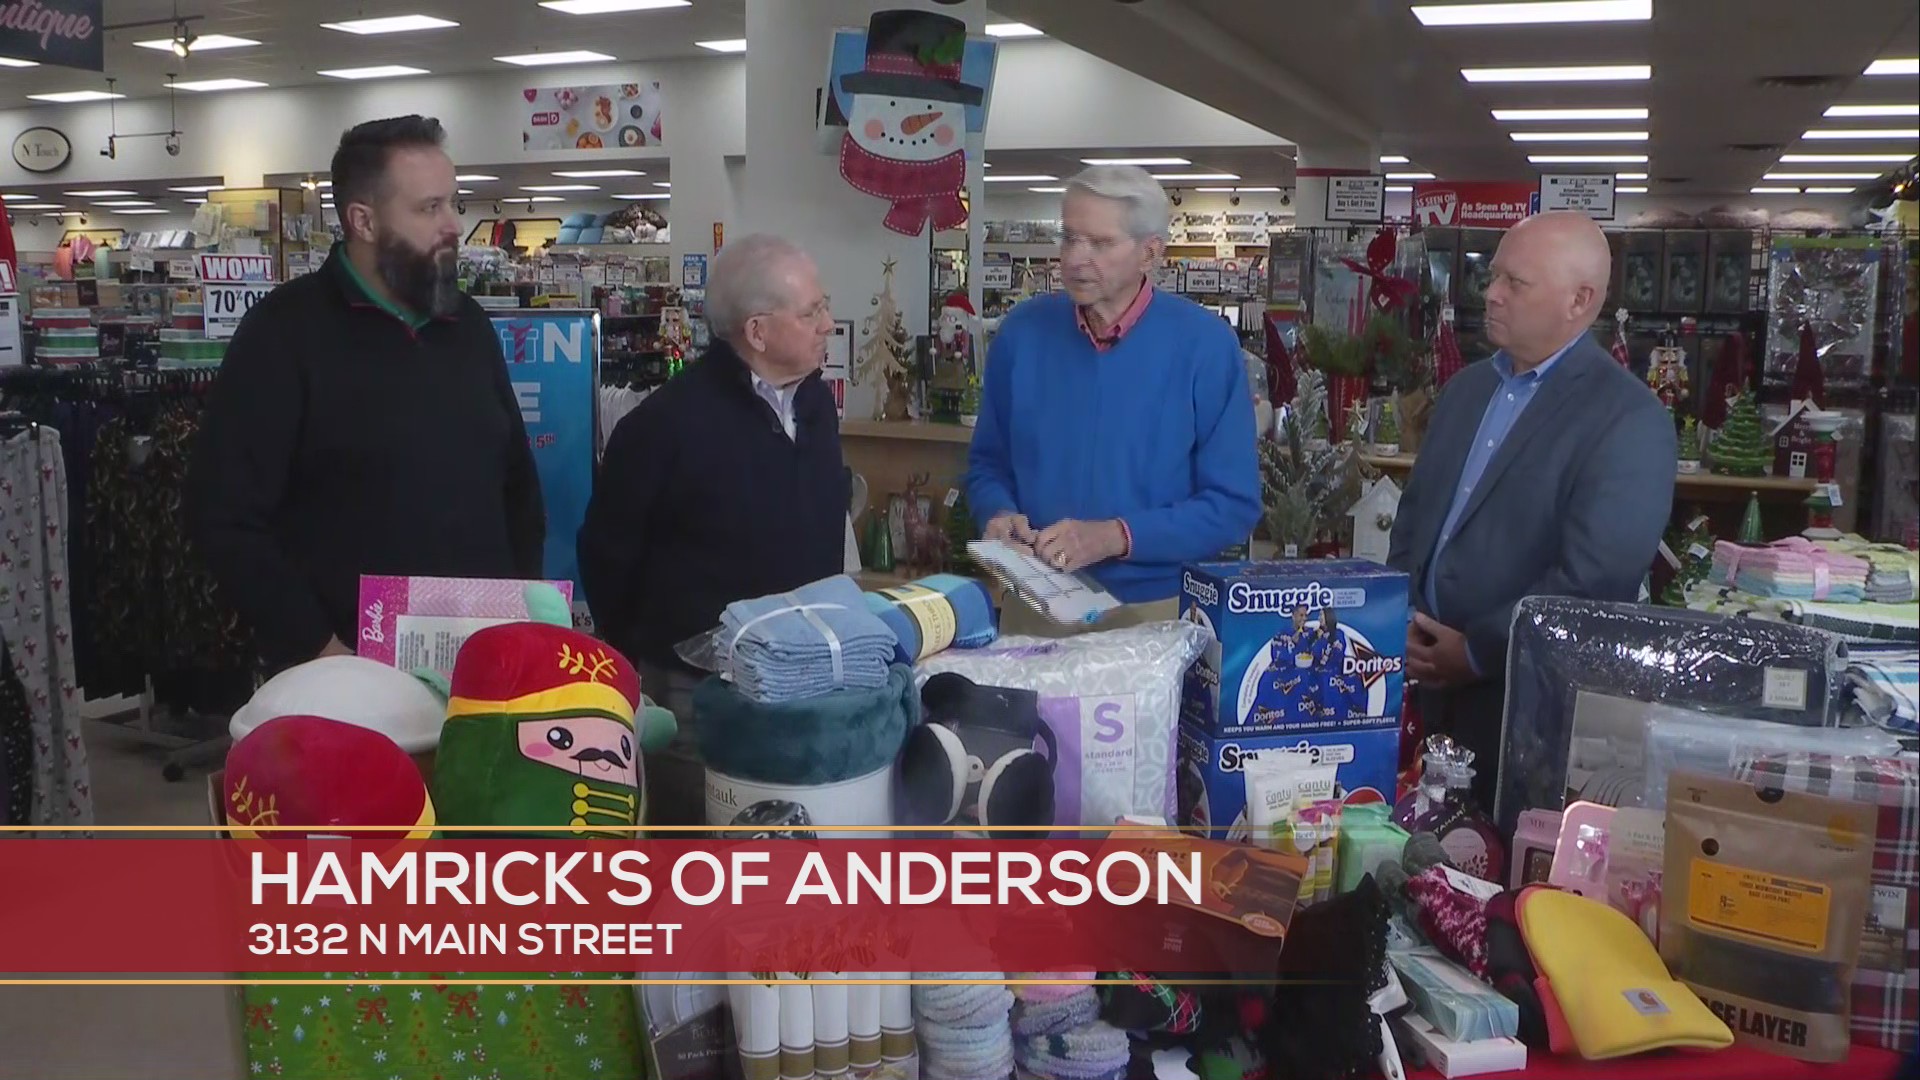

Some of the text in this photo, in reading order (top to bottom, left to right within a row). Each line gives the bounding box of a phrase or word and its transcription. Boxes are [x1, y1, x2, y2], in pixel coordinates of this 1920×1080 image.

[22, 143, 60, 157] N Touch
[1425, 195, 1443, 206] SEEN
[1444, 193, 1456, 202] ON
[1462, 202, 1528, 212] As Seen On TV
[1416, 202, 1457, 225] TV
[1461, 210, 1527, 221] Headquarters!
[203, 257, 273, 281] WOW!
[210, 289, 243, 314] 70%
[1183, 571, 1219, 605] Snuggie
[1228, 581, 1334, 618] Snuggie
[362, 598, 385, 644] Barbie
[1343, 654, 1403, 676] Doritos
[1093, 702, 1124, 743] S
[1224, 726, 1243, 734] KEEPS
[1255, 724, 1272, 732] WARM
[1285, 722, 1300, 730] YOUR
[1301, 721, 1319, 729] HANDS
[1085, 747, 1133, 760] standard
[1297, 779, 1331, 792] cantu
[1265, 788, 1292, 804] cantu
[1739, 1008, 1808, 1048] LAYER
[688, 1051, 704, 1059] Pack
